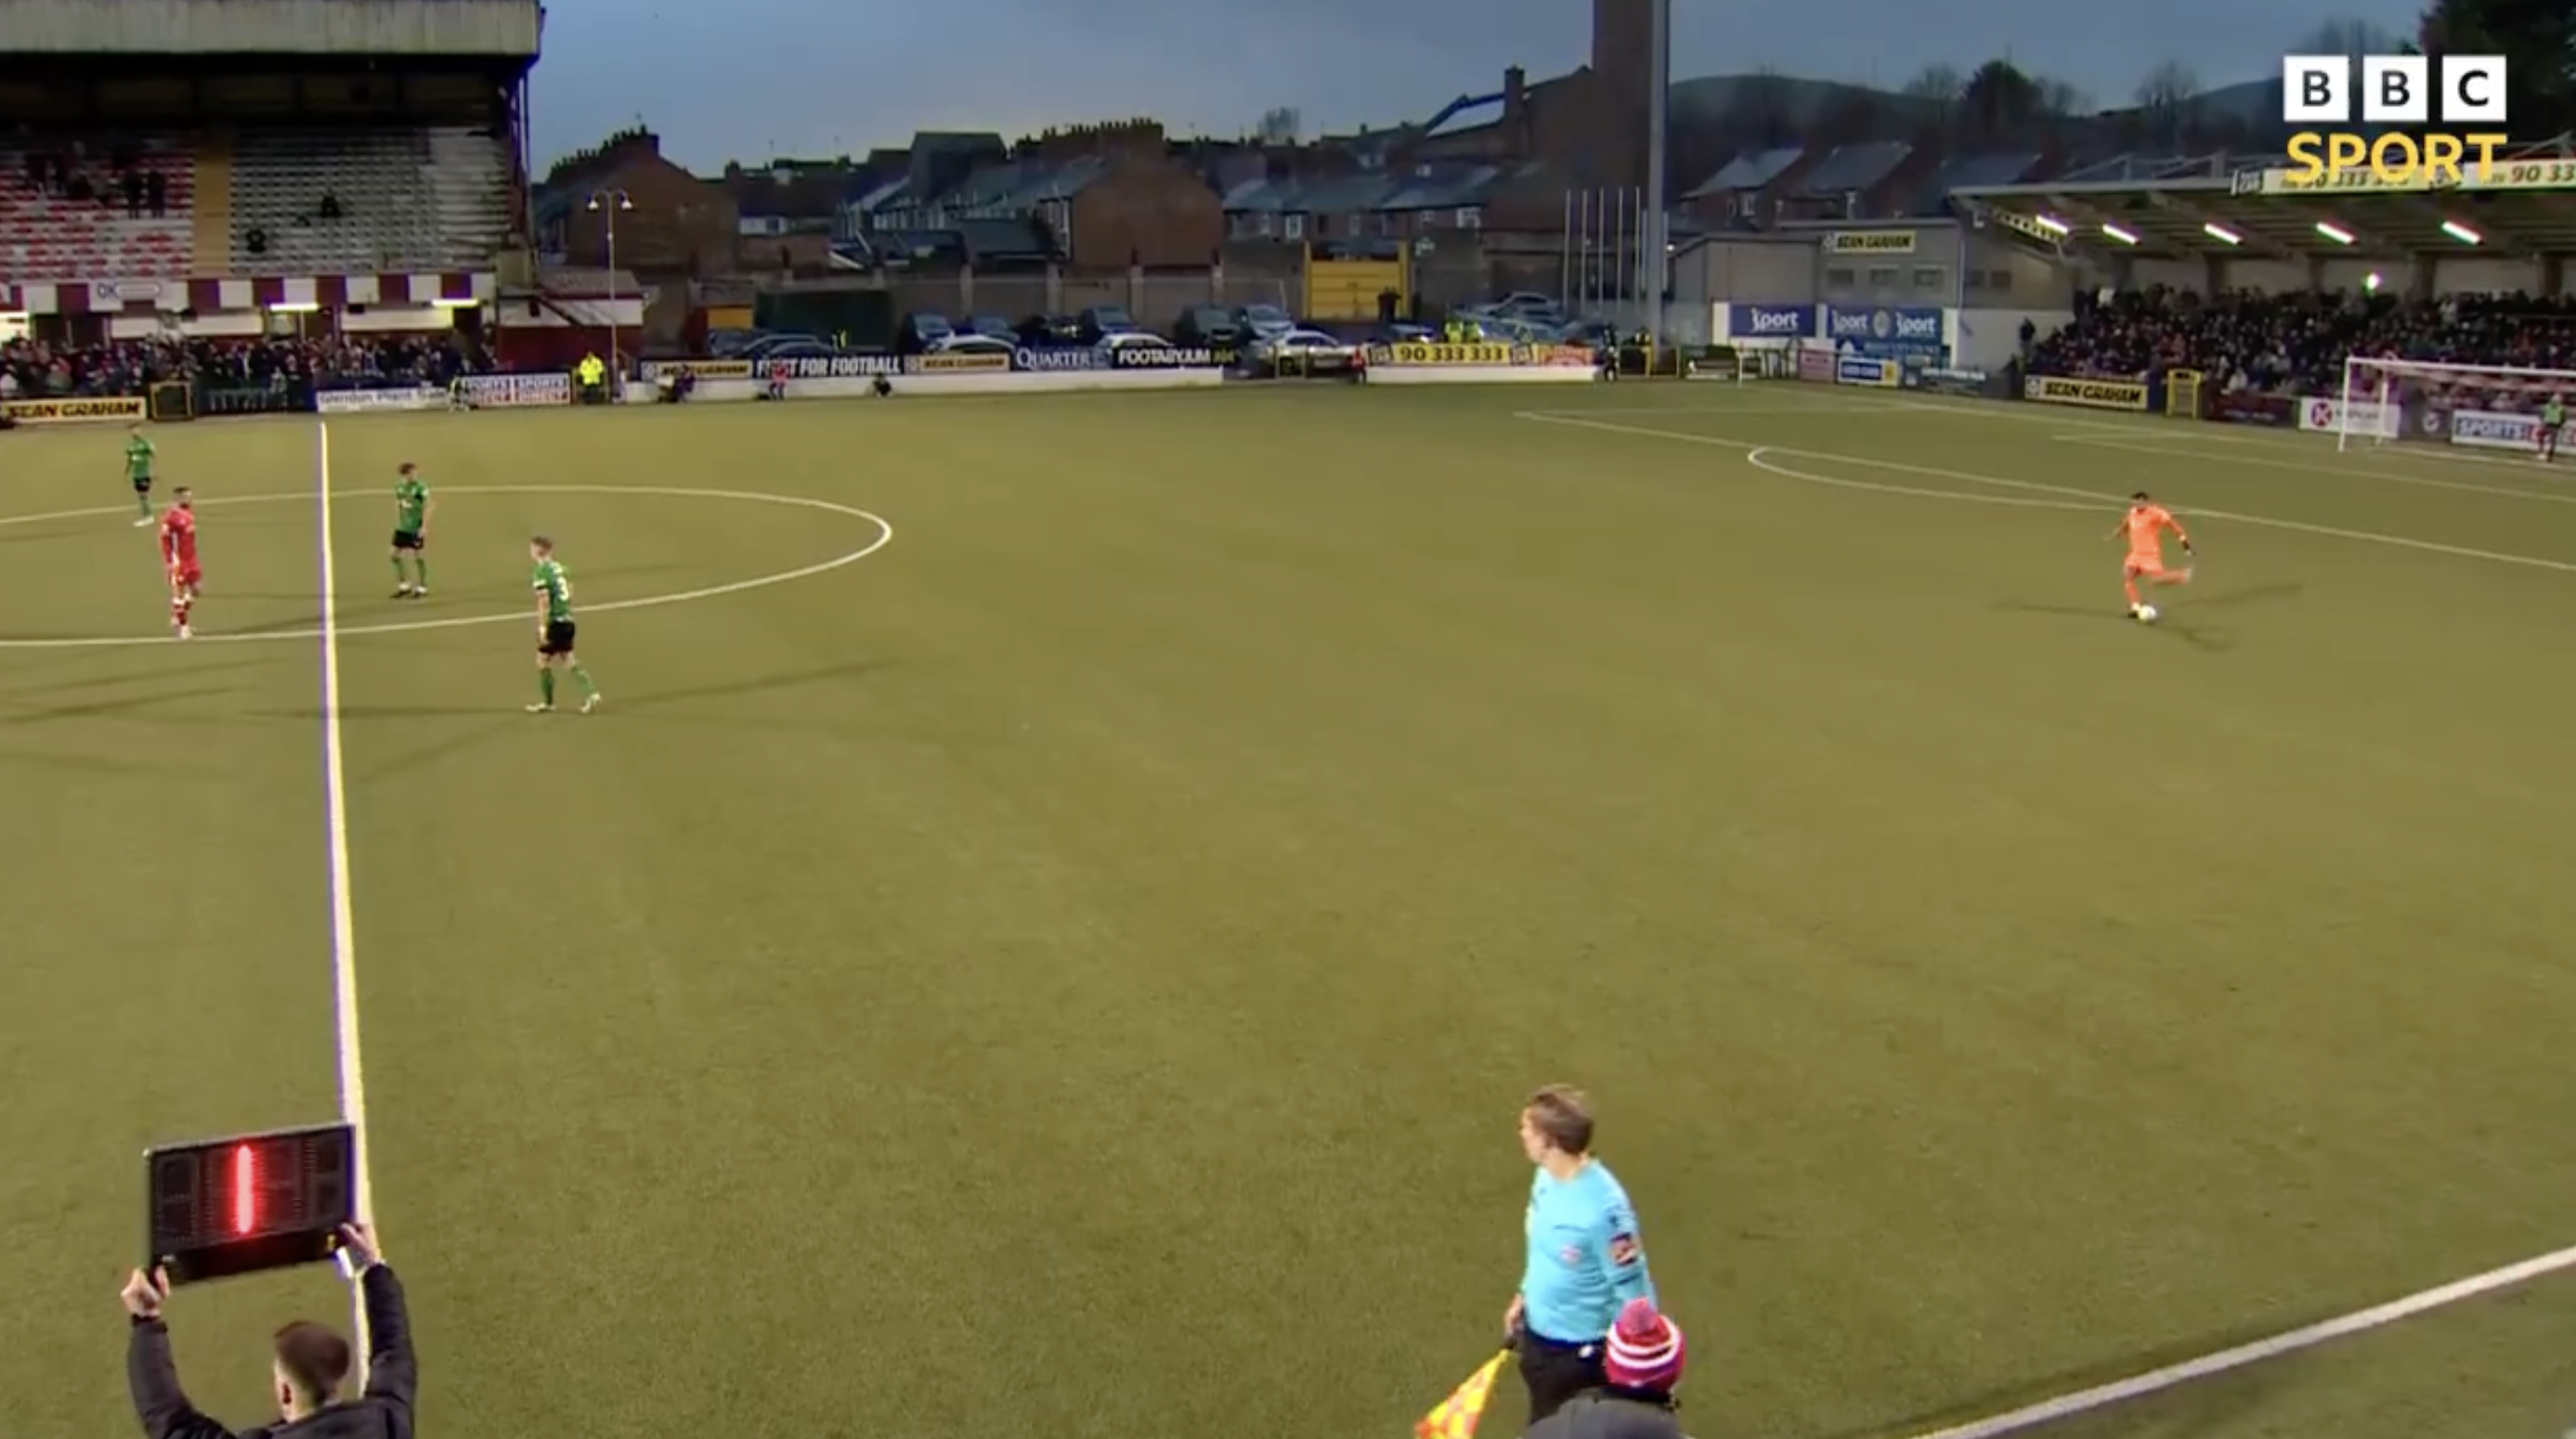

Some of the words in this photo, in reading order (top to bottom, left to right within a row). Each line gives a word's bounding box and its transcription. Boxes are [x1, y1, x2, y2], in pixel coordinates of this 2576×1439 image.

[2511, 164, 2541, 183] 90
[1399, 345, 1426, 362] 90
[1433, 345, 1465, 362] 333
[1471, 345, 1503, 362] 333
[800, 357, 828, 377] FOR
[830, 355, 901, 376] FOOTBALL
[2045, 381, 2080, 396] SEAN
[2083, 384, 2142, 403] GRAHAM
[60, 401, 139, 417] GRAHAM
[2458, 417, 2524, 439] SPORTS
[235, 1143, 255, 1234] 1
